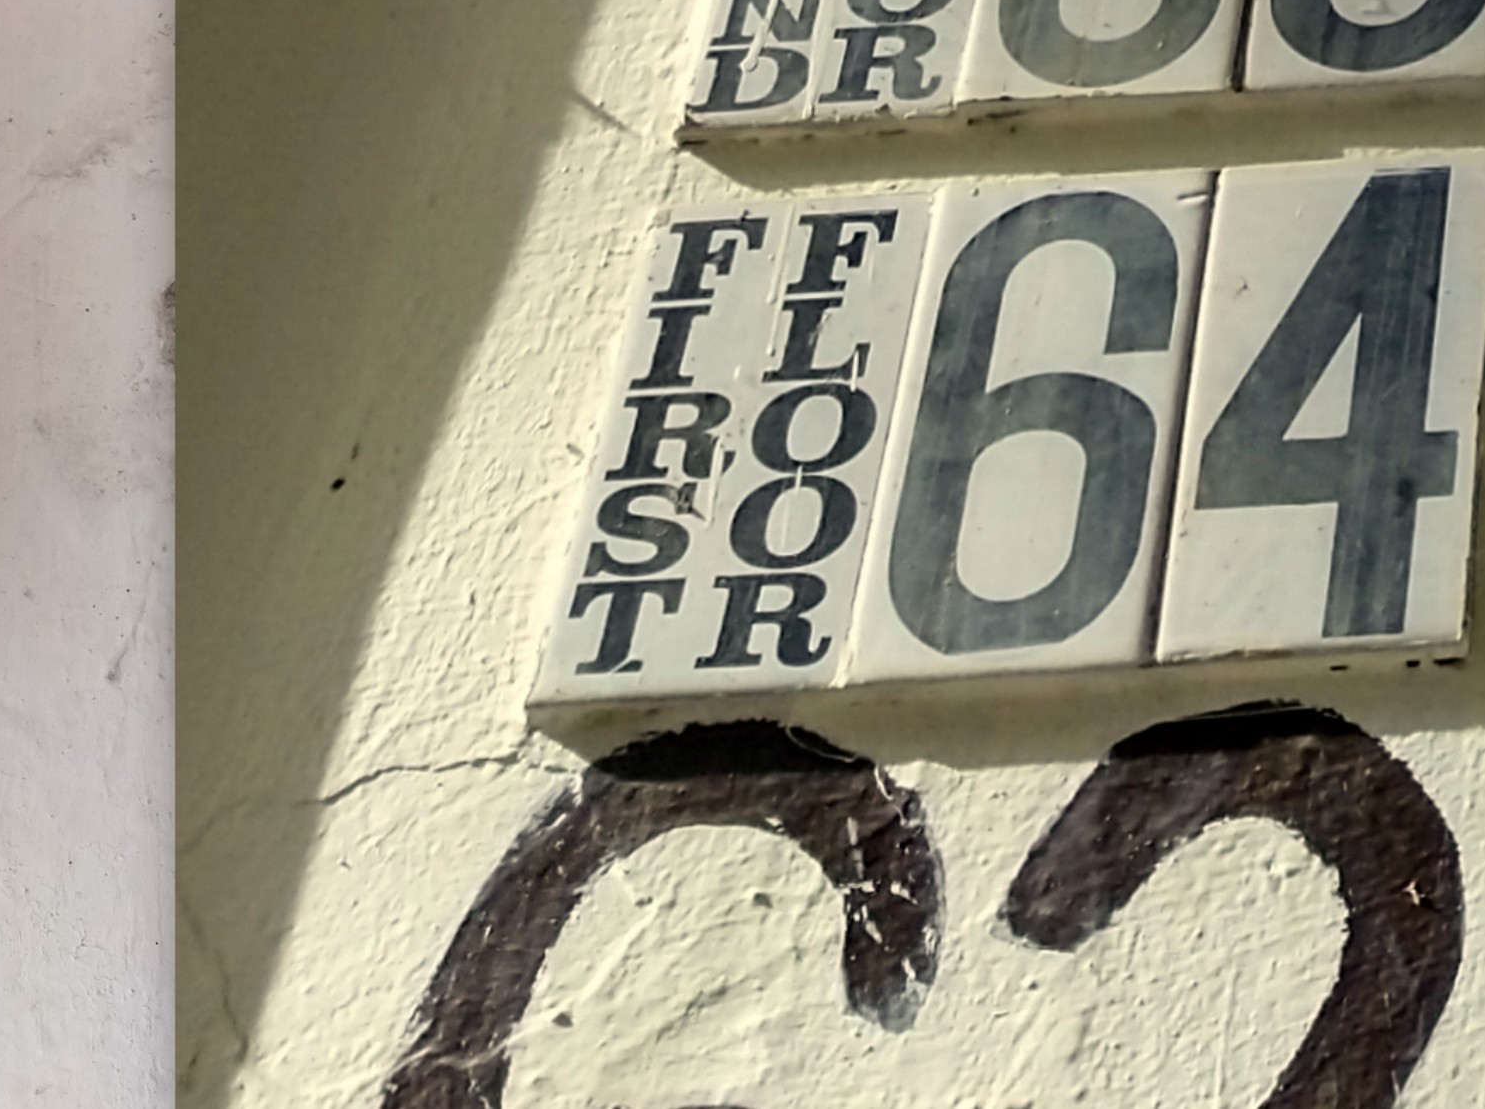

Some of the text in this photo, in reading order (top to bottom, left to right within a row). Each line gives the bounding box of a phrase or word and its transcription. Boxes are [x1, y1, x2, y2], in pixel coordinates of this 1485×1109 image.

[568, 208, 898, 673] FIRST FLOOR
[887, 166, 1459, 655] 64
